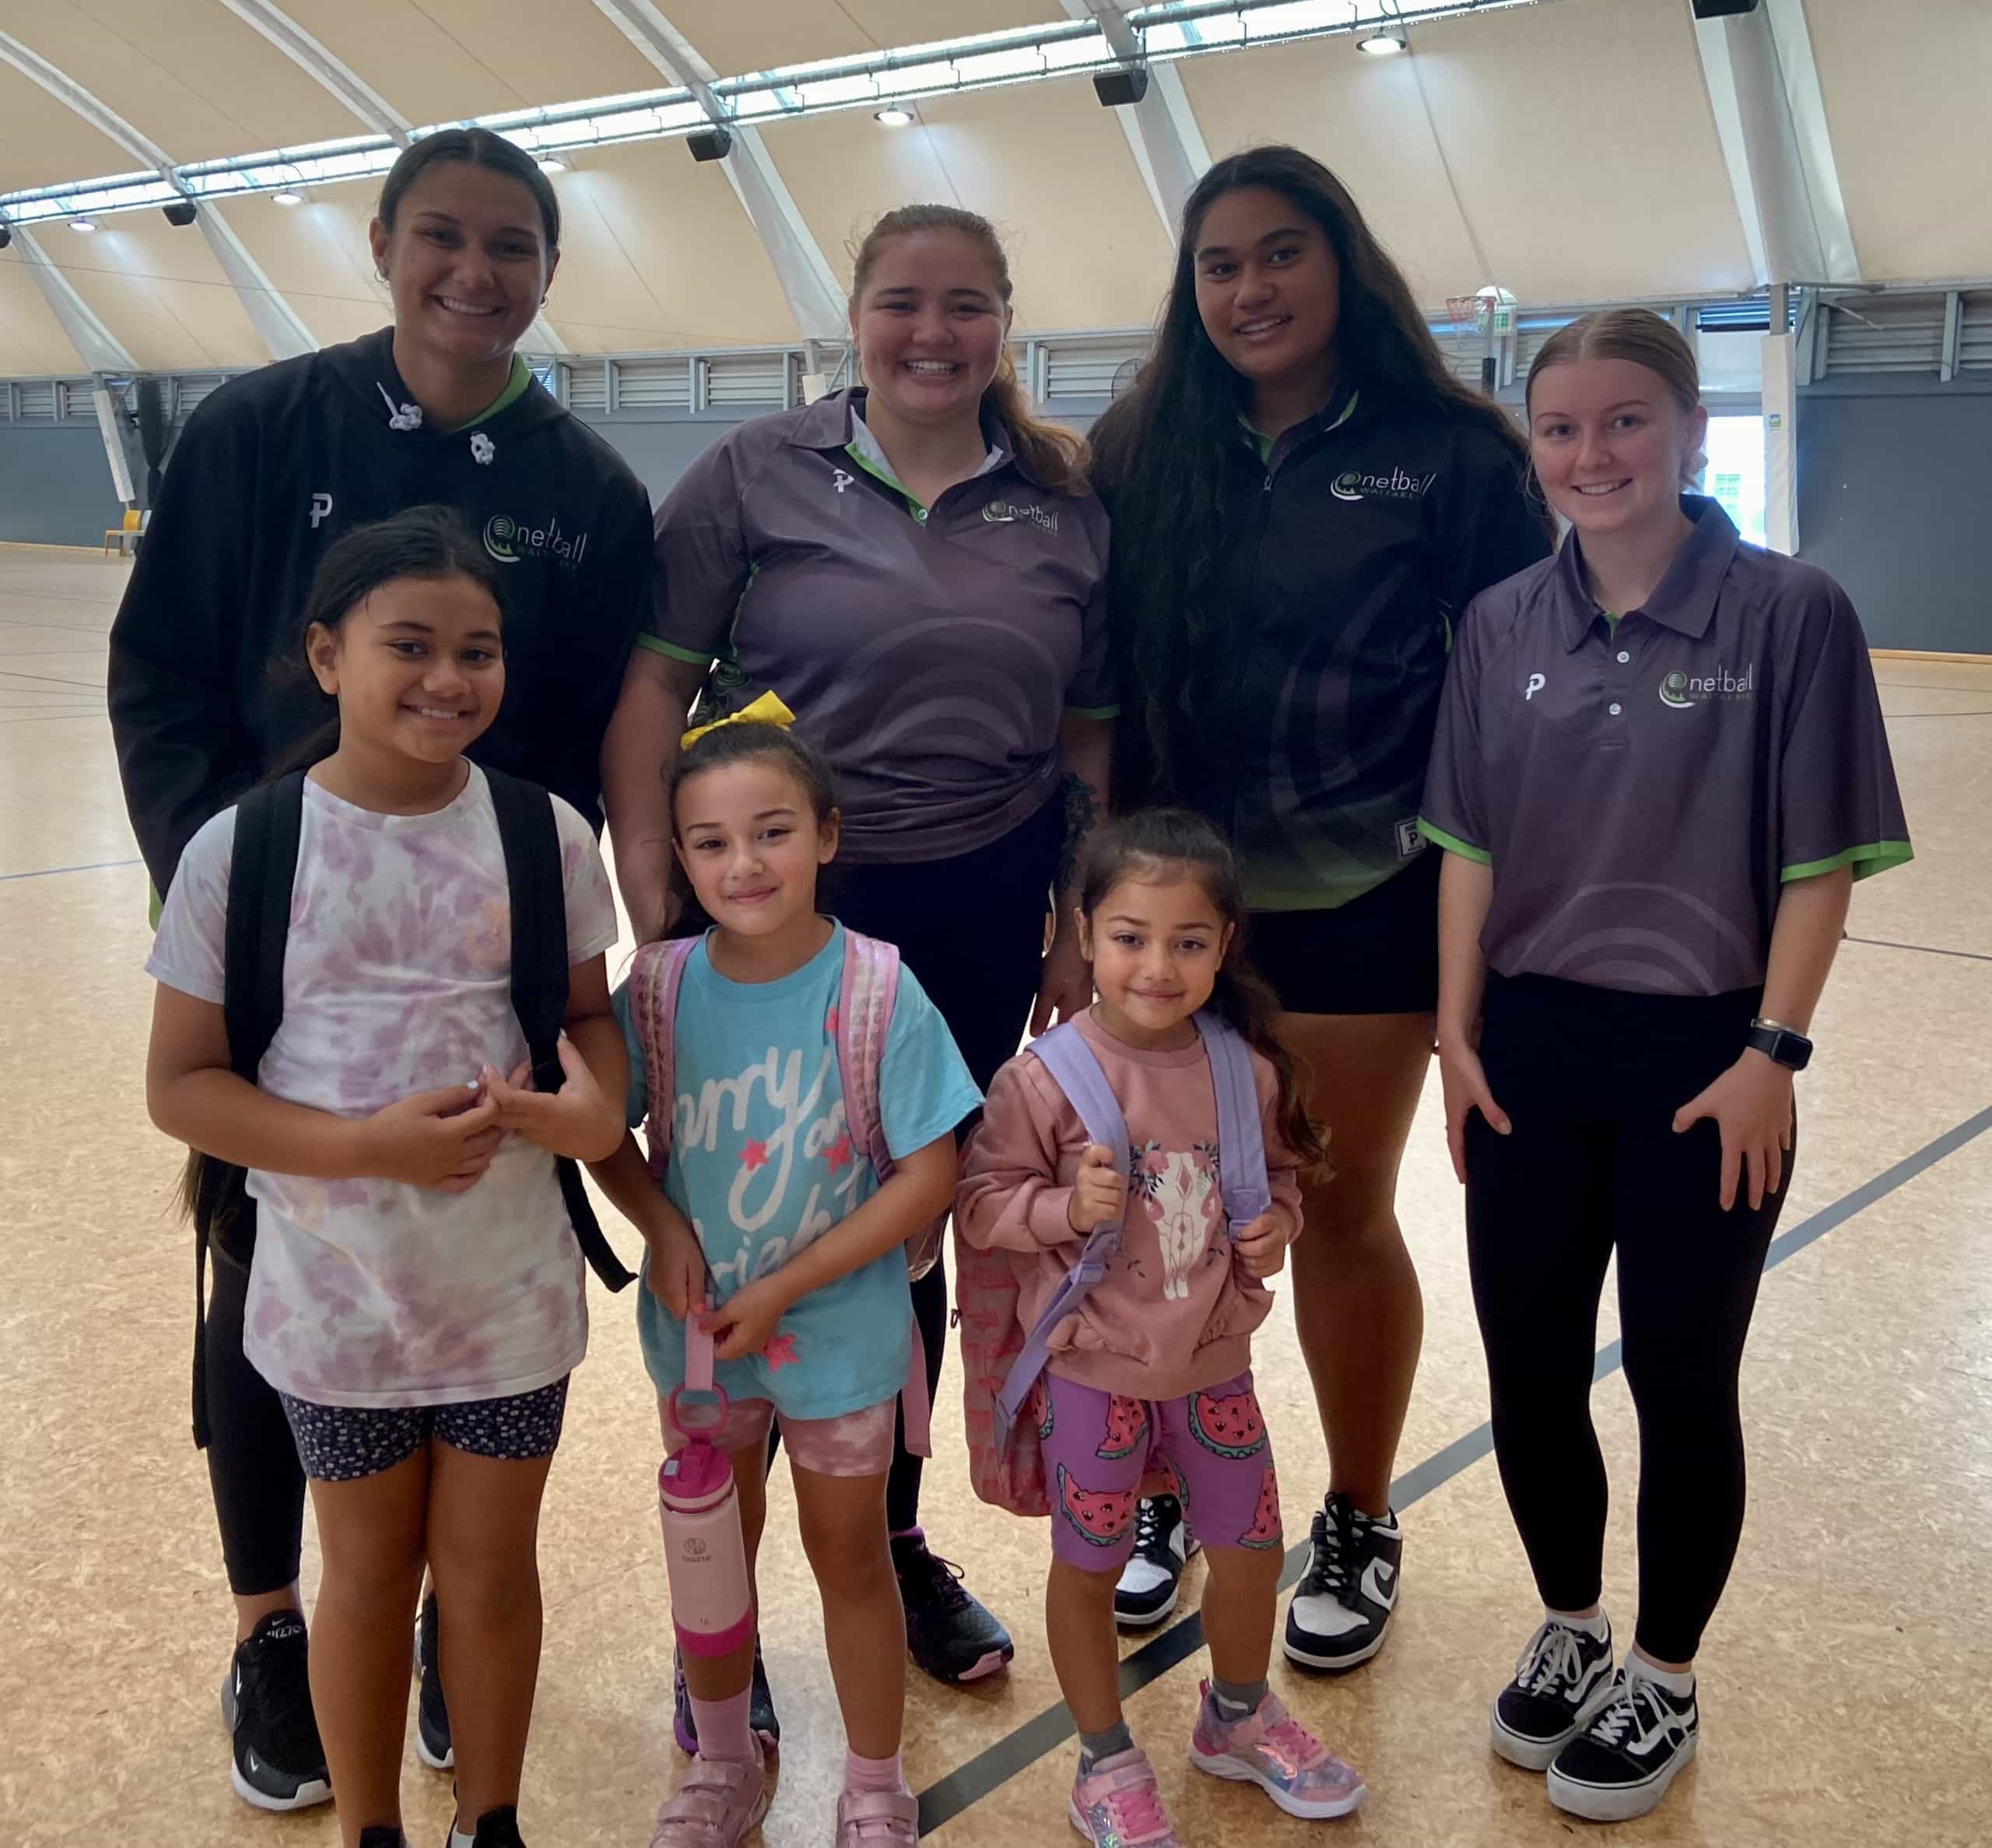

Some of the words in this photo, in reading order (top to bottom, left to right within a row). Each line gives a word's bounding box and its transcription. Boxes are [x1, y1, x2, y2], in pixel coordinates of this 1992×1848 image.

[1362, 466, 1436, 496] netball
[1008, 503, 1059, 531] netball
[517, 516, 587, 563] netball
[1689, 662, 1753, 692] netball
